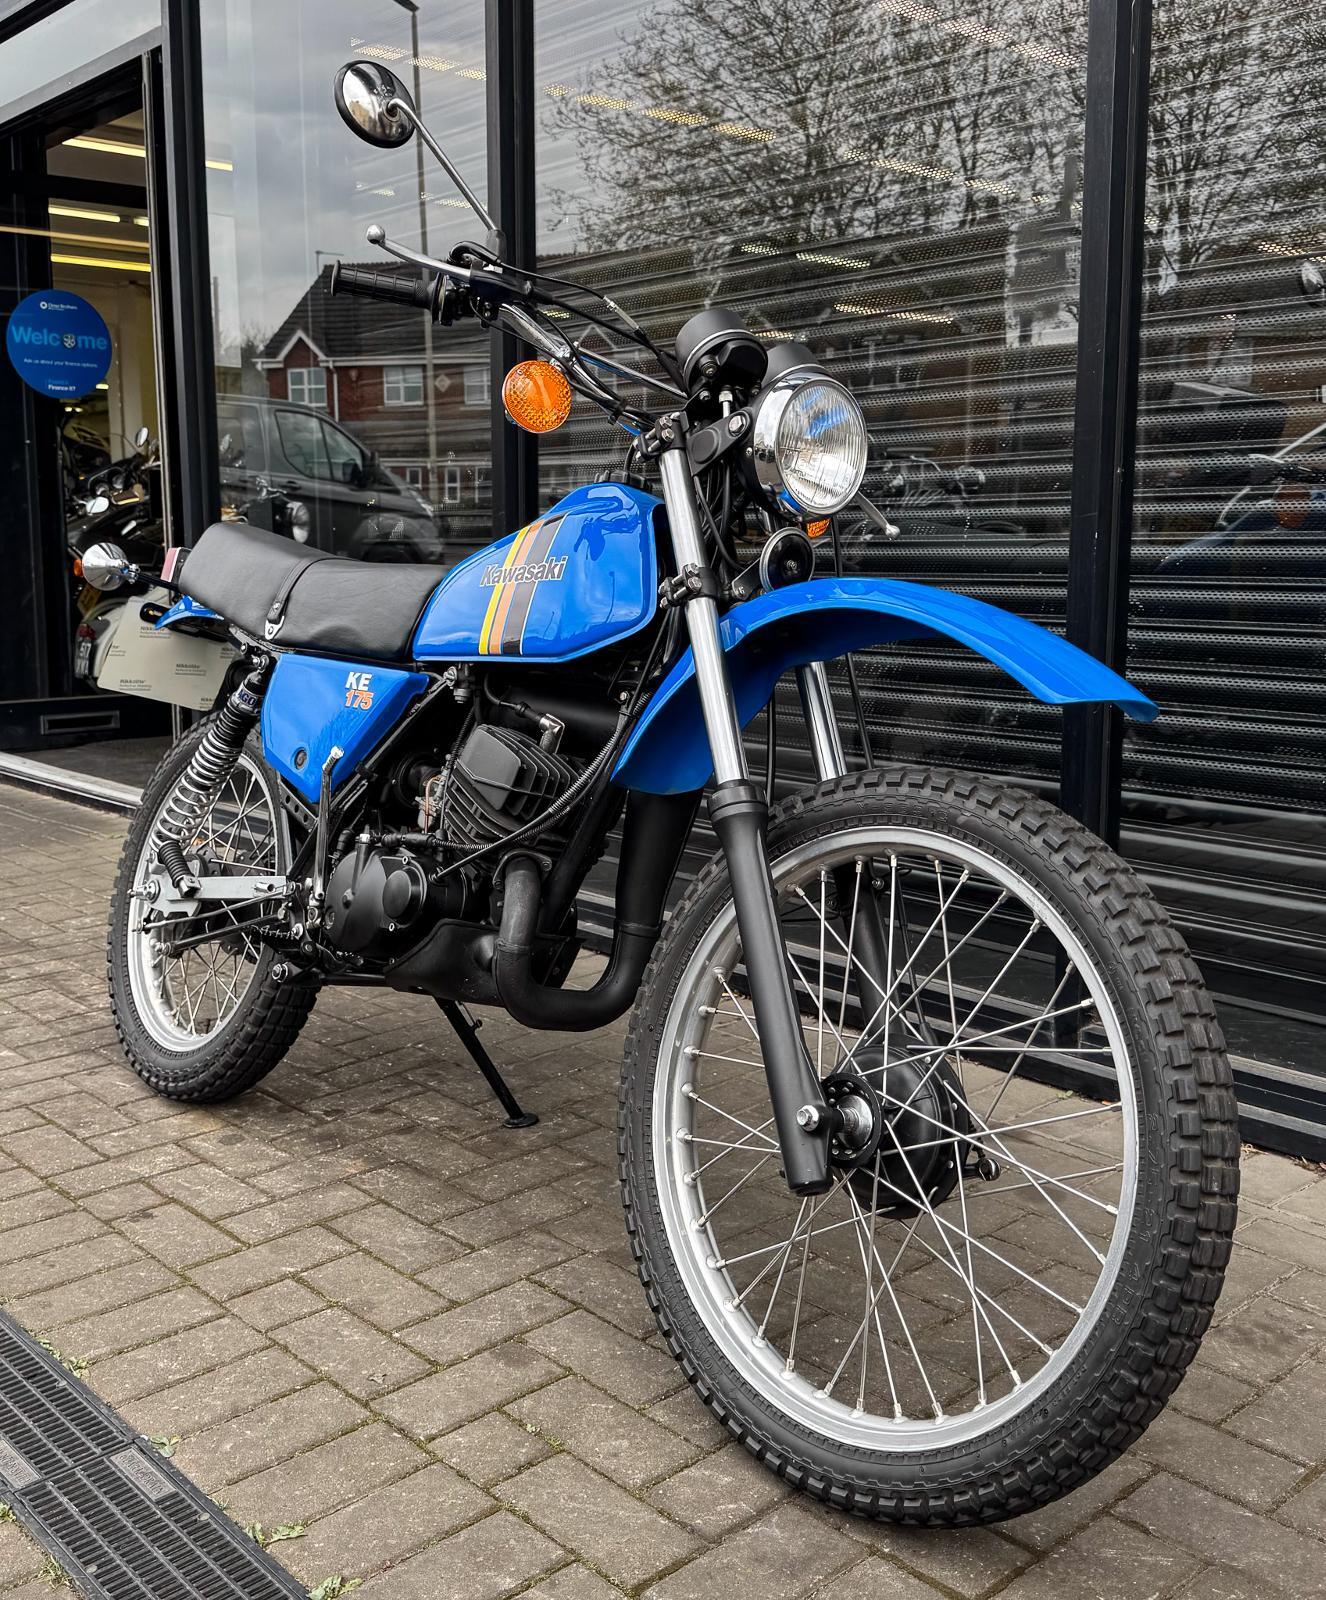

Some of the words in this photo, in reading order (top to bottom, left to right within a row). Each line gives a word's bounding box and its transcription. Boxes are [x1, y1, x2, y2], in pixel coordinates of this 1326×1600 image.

[480, 556, 568, 587] Kawasaki
[345, 671, 372, 690] KE
[345, 690, 374, 710] 175
